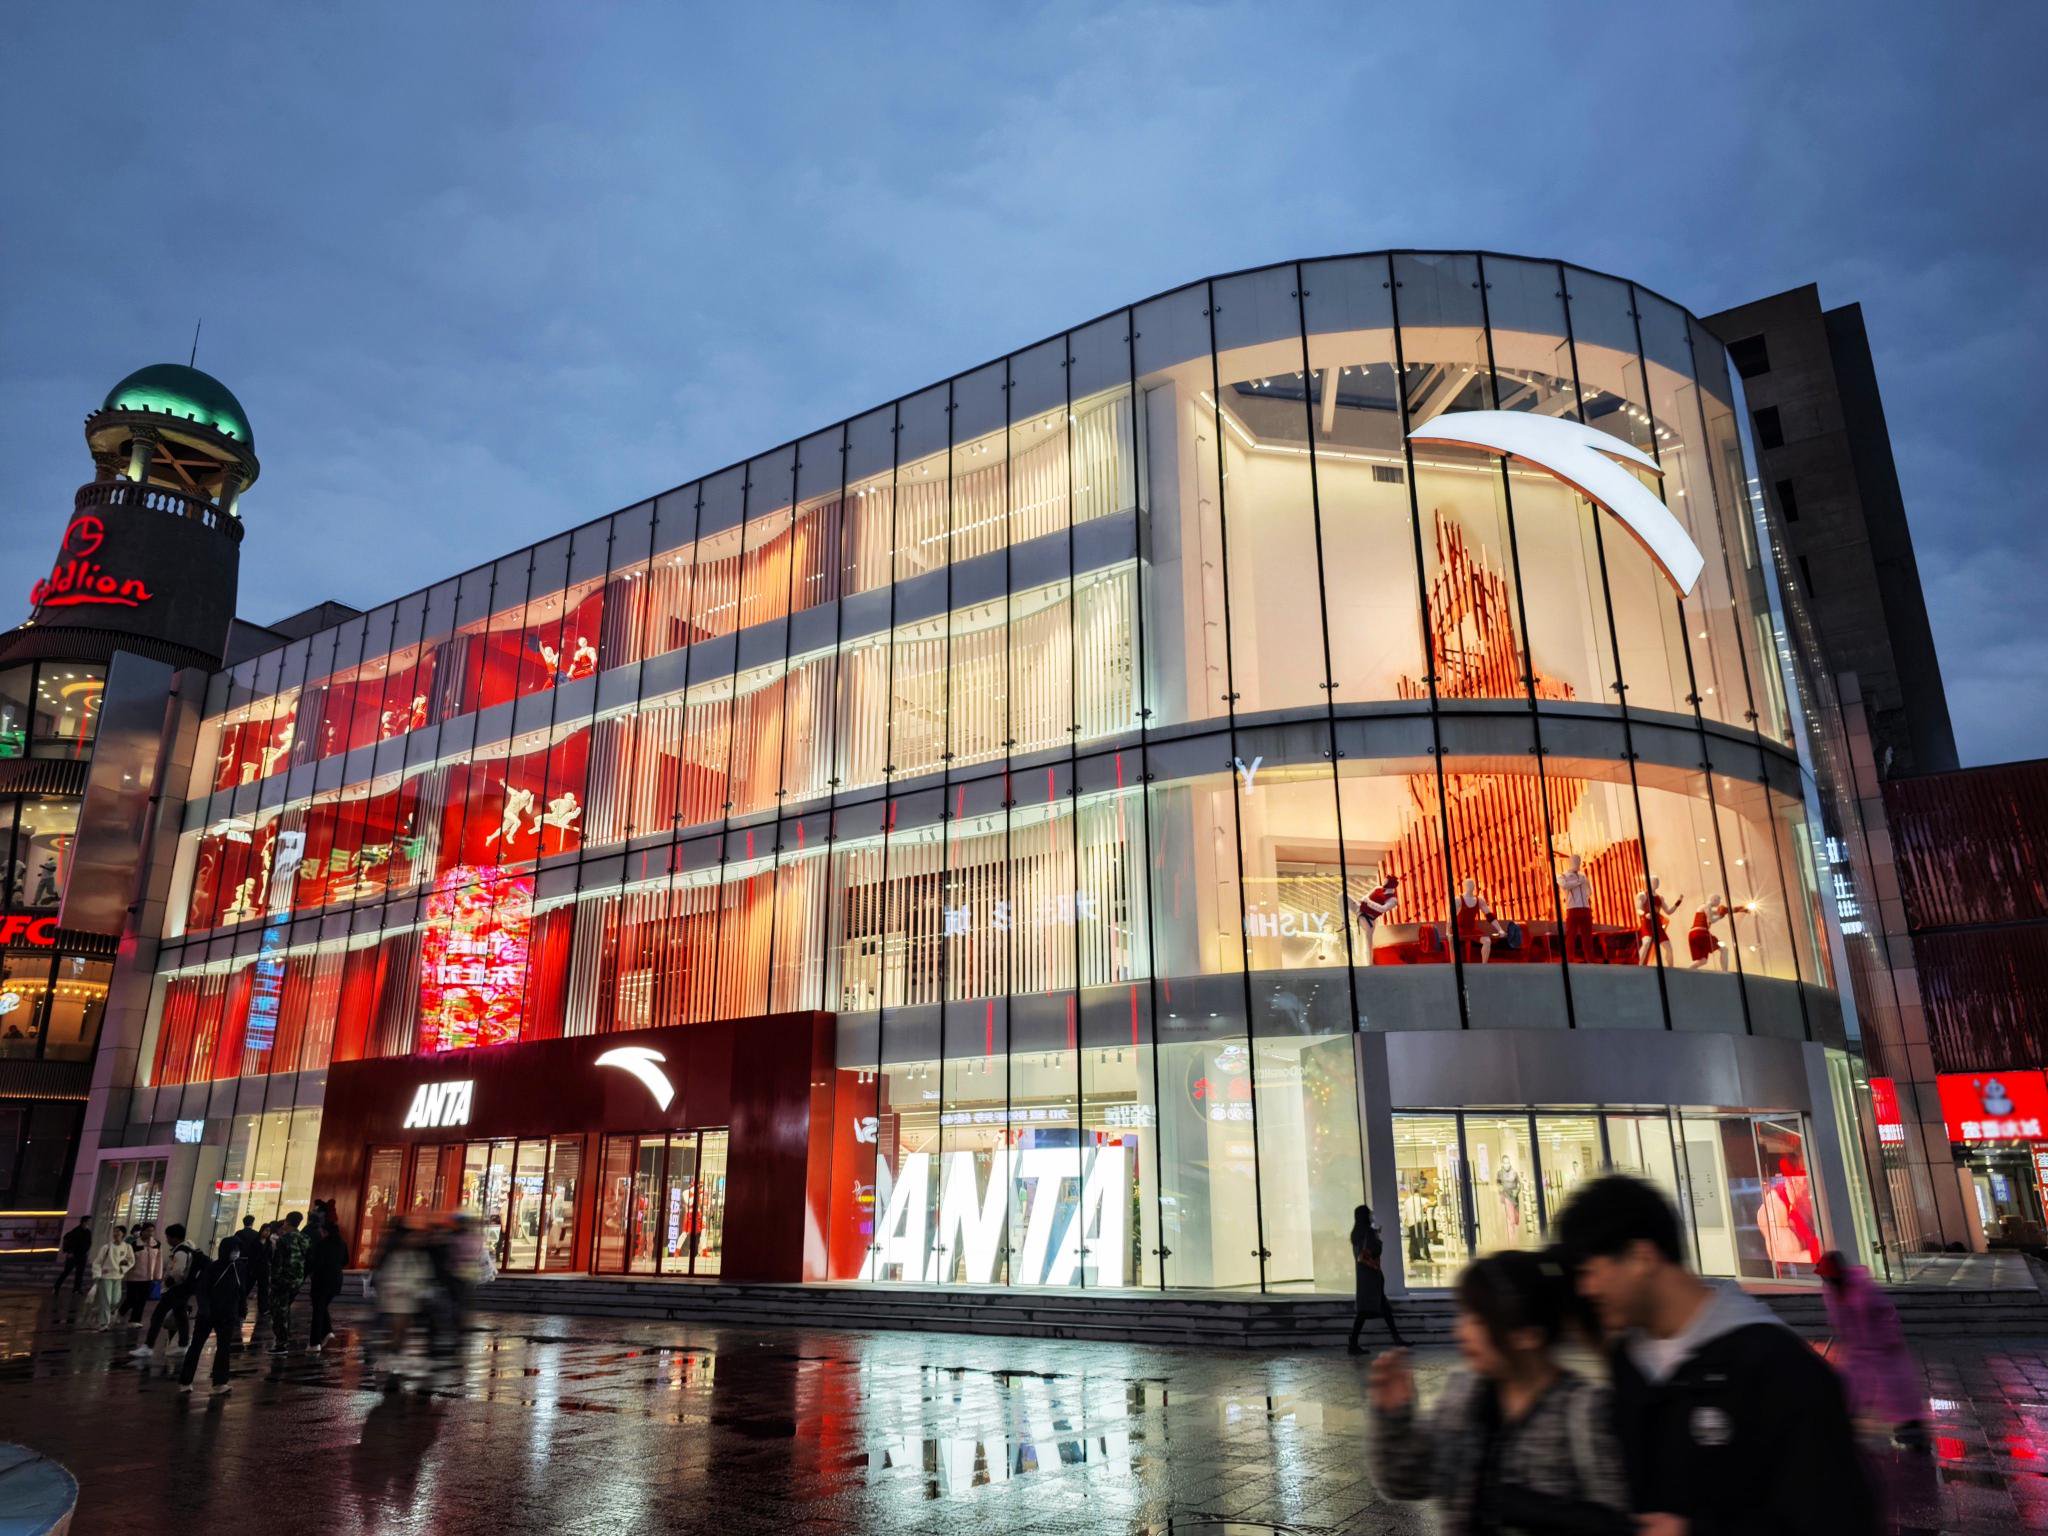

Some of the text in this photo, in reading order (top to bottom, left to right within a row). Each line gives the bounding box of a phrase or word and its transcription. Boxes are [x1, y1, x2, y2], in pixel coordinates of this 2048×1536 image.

[0, 915, 58, 945] FC
[403, 1080, 474, 1129] ANTA
[859, 1146, 1126, 1287] ANTA
